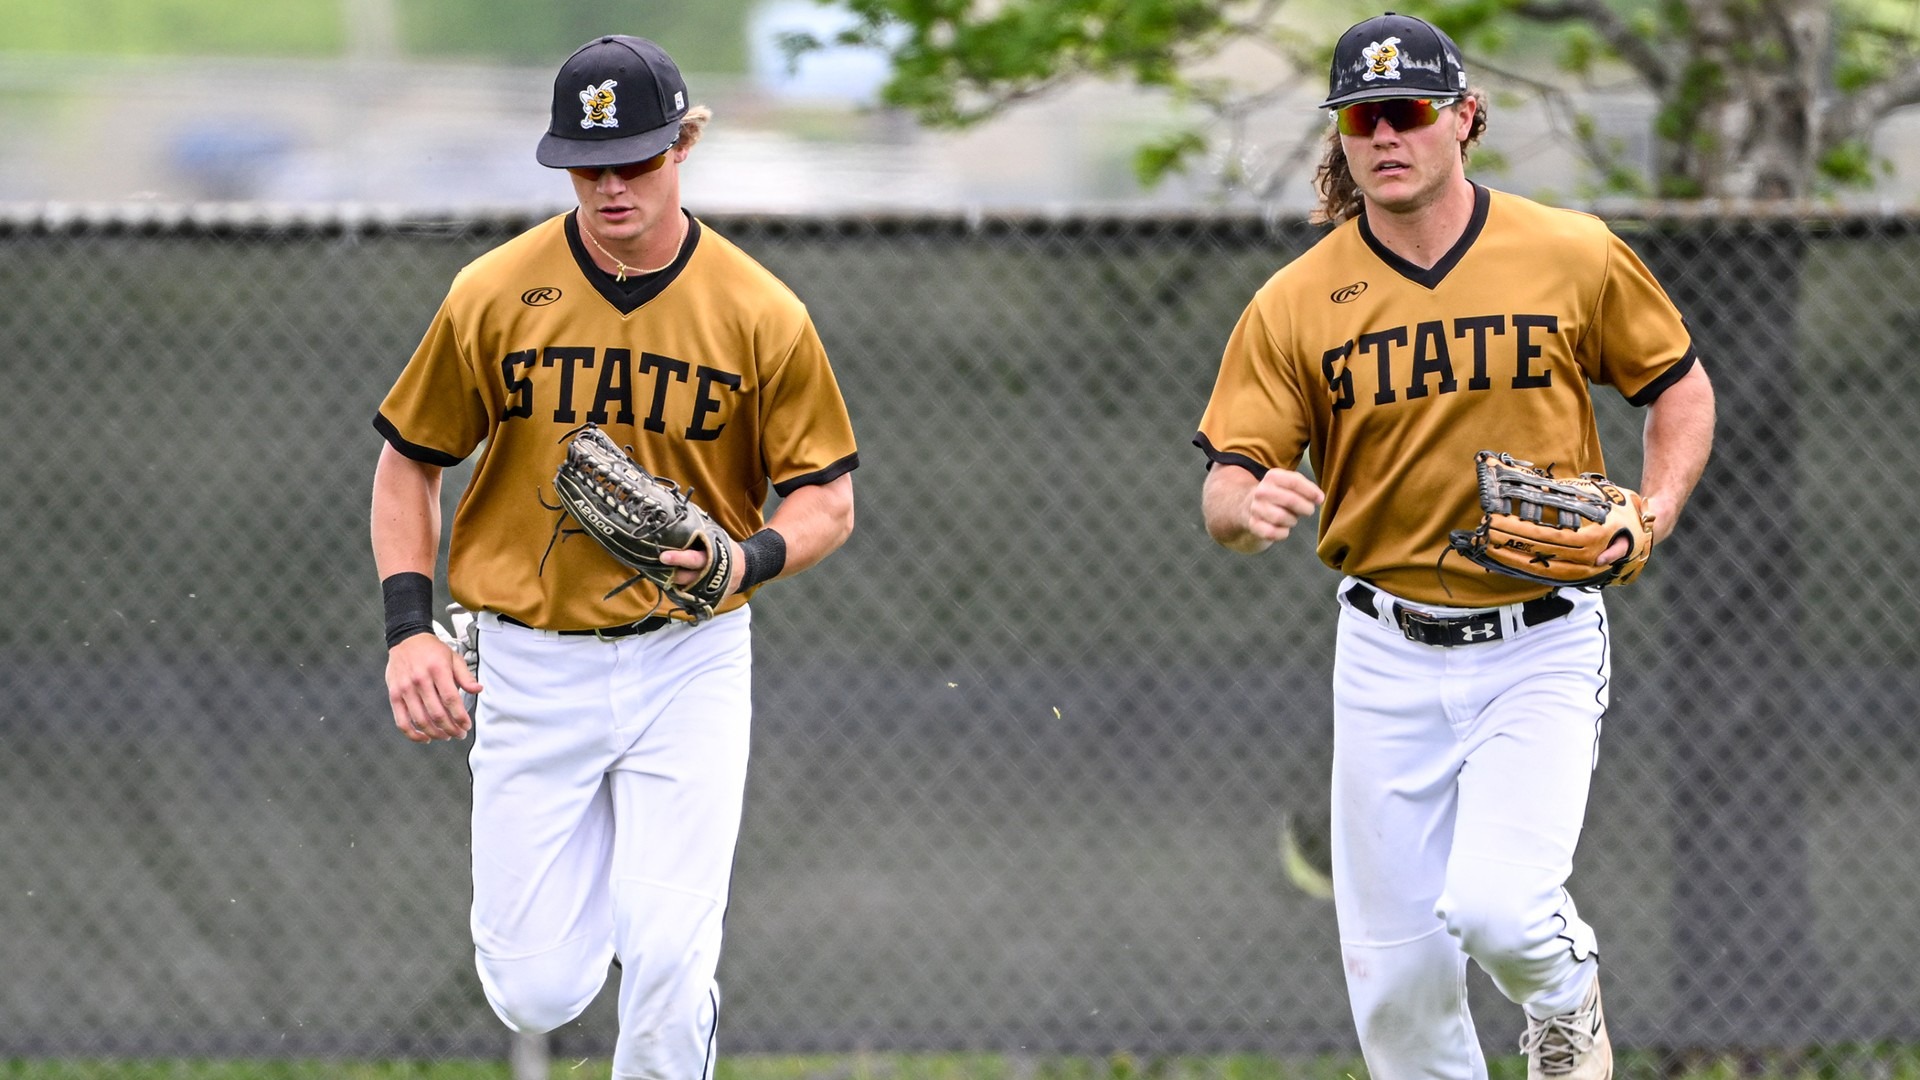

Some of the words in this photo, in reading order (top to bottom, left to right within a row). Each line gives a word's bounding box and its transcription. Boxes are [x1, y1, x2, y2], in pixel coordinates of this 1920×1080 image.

[525, 287, 555, 304] R
[1322, 314, 1558, 412] STATE
[500, 346, 741, 441] STATE
[574, 499, 615, 535] A2000
[707, 540, 728, 589] Wilson
